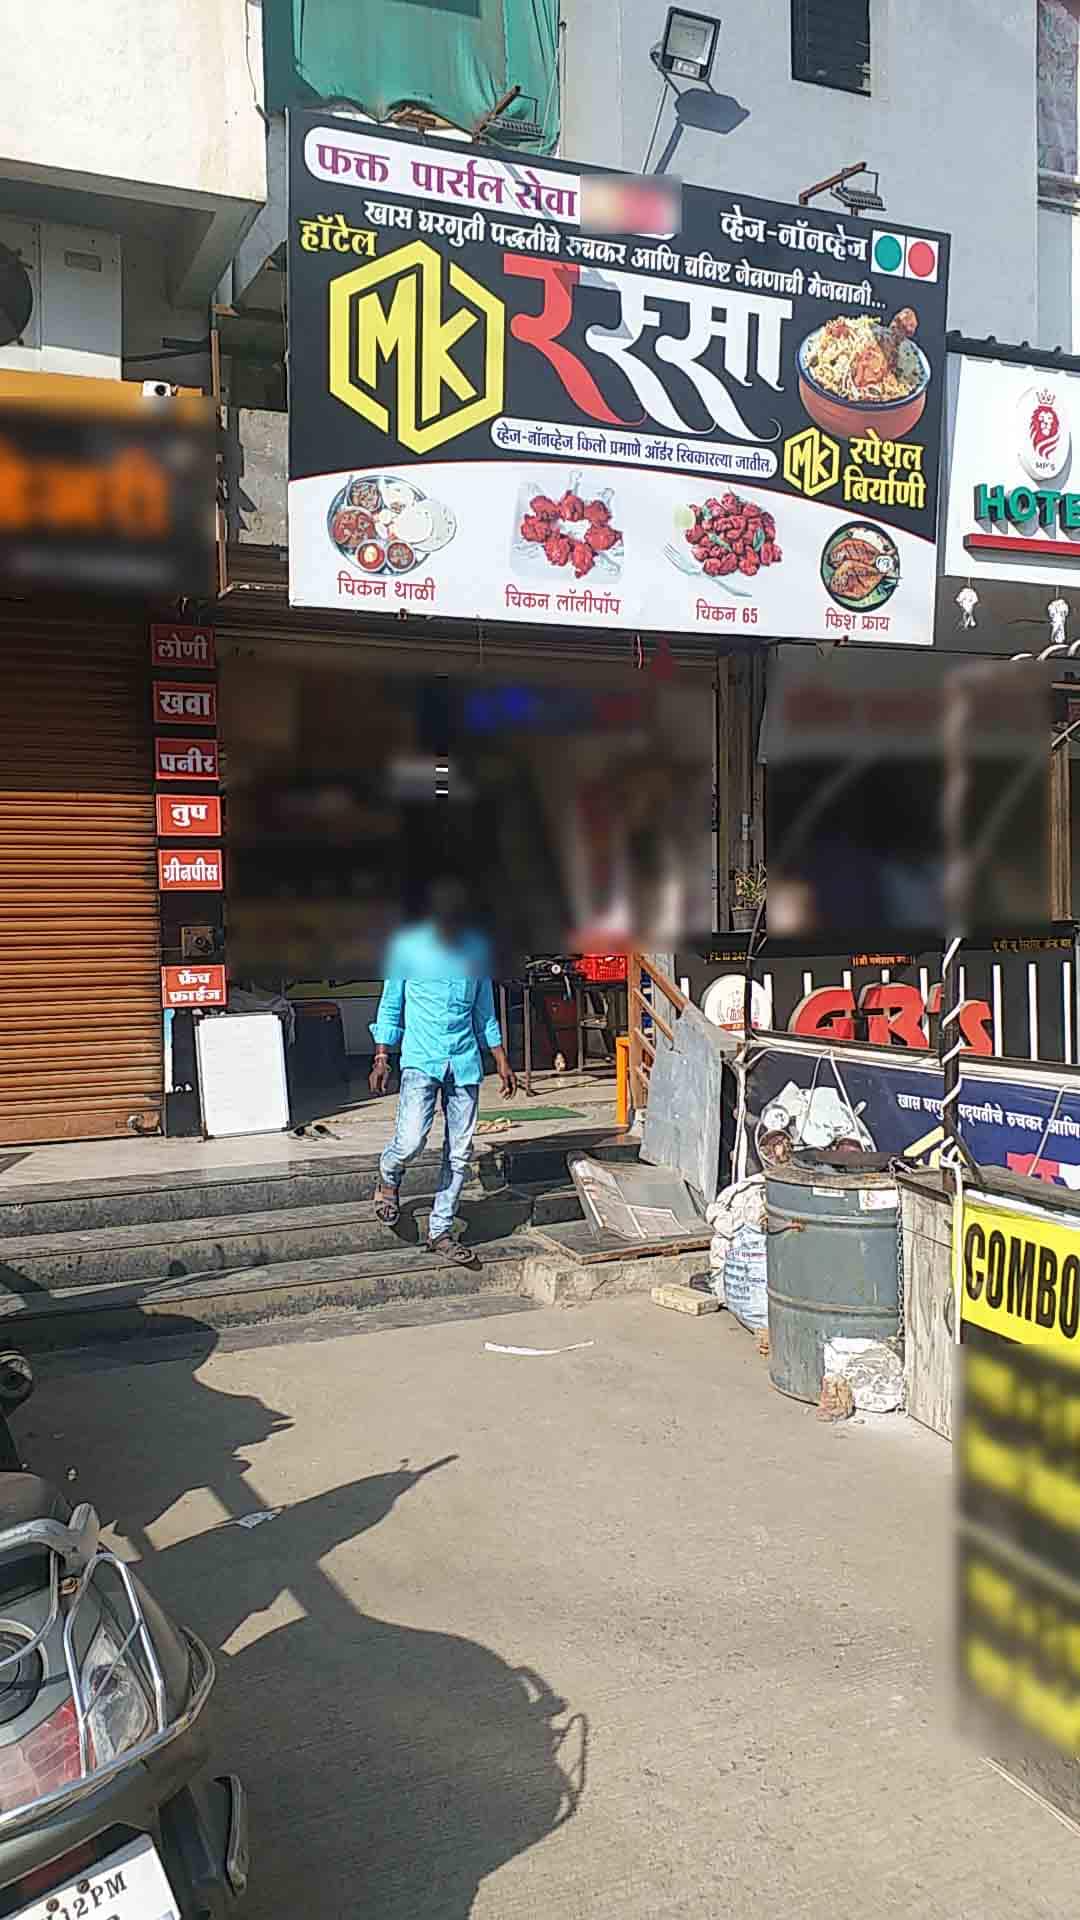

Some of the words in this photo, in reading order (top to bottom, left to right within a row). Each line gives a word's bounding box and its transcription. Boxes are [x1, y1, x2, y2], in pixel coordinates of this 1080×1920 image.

[315, 143, 389, 183] फक्त
[411, 160, 506, 204] पार्सल
[514, 170, 578, 217] सेवा
[299, 213, 378, 257] हॉटेल
[363, 201, 415, 230] खास
[417, 209, 486, 247] घरगुती
[565, 235, 627, 267] रुचकर
[630, 244, 681, 275] आणि
[503, 253, 795, 443] रस्सा
[849, 427, 924, 471] स्पेशल
[842, 464, 927, 508] बिर्याणी
[337, 570, 387, 598] चिकन
[394, 576, 436, 601] थाळी
[504, 583, 550, 610] चिकन
[696, 598, 737, 623] चिकन
[742, 606, 759, 625] 65
[825, 606, 857, 629] फिश
[156, 632, 209, 660] लोणी
[159, 690, 211, 717] खवा
[160, 746, 215, 773] पनीर
[171, 803, 208, 827] तुप
[897, 1093, 921, 1110] खास
[965, 1223, 1080, 1339] COMBO
